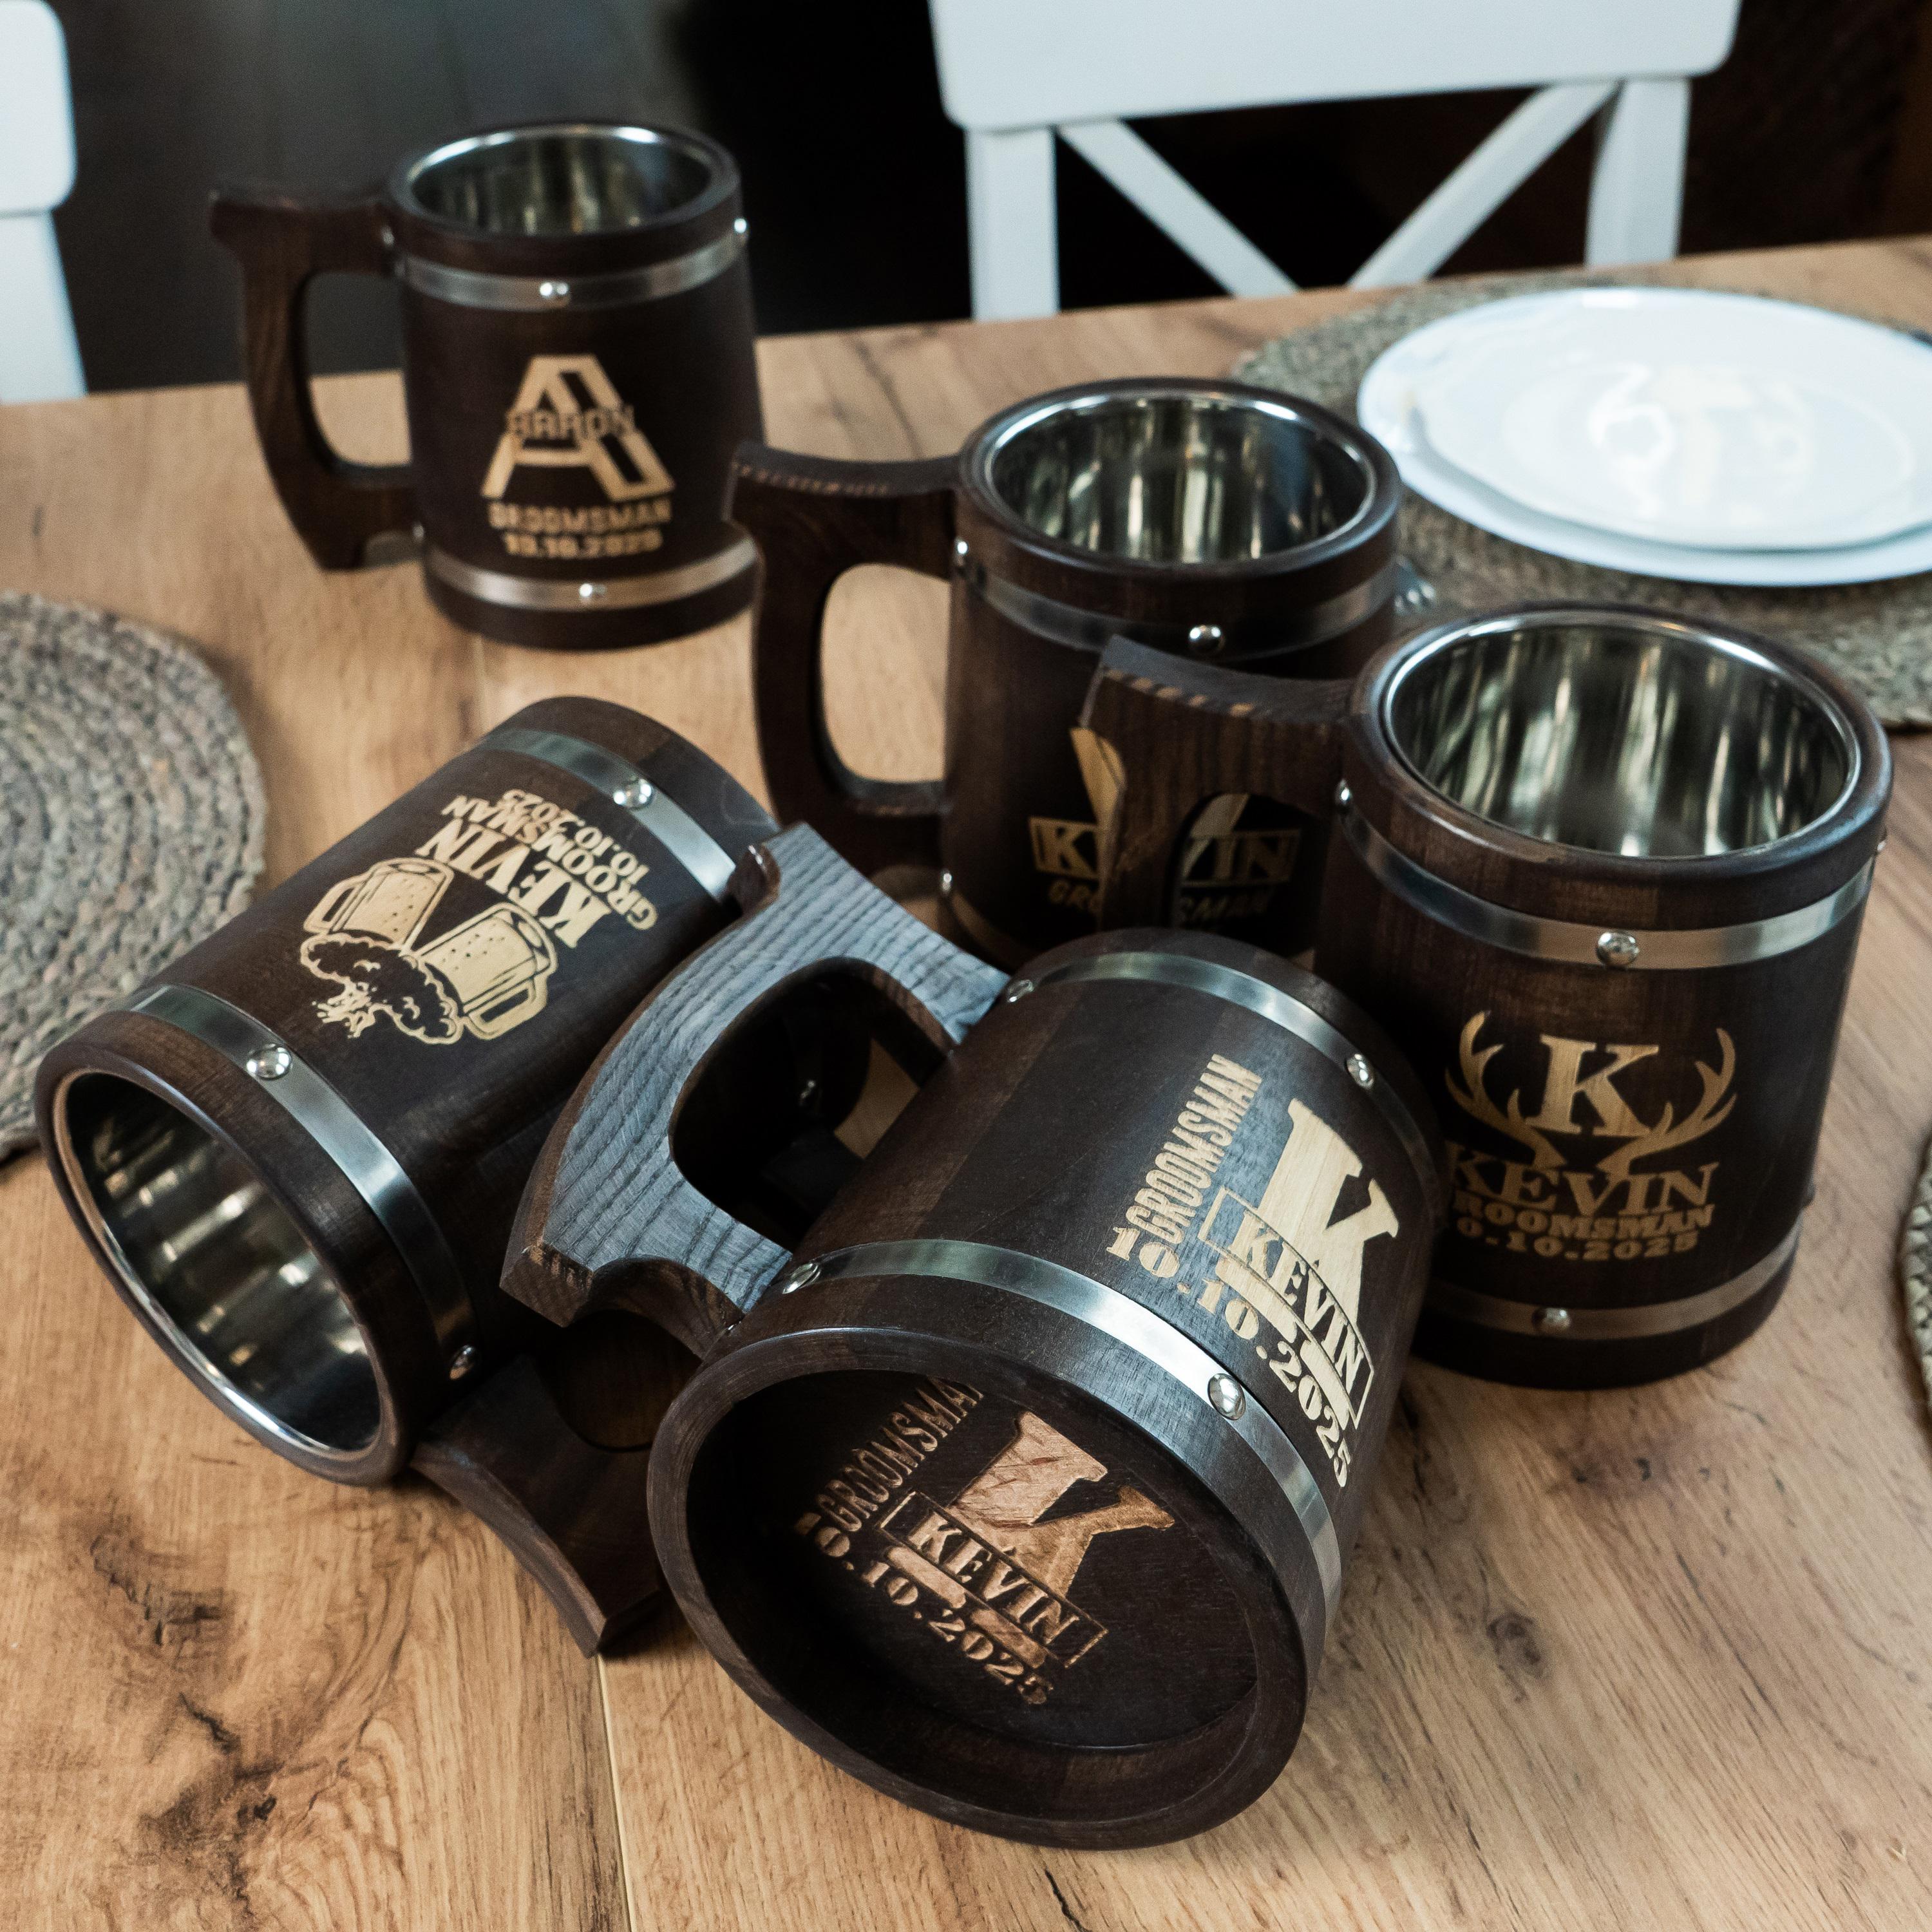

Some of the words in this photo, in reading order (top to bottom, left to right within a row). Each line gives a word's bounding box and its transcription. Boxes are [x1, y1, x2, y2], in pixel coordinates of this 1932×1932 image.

[482, 354, 674, 502] A
[415, 819, 612, 948] KEVIN
[441, 795, 658, 930] GROOMSMAN
[1126, 1054, 1262, 1244] GROOMSMAN
[1525, 1034, 1660, 1137] K
[1445, 1140, 1719, 1217] KEVIN
[1455, 1189, 1715, 1240] ROOMSMAN
[1216, 1098, 1399, 1431] K
[1226, 1209, 1364, 1395] KEVIN
[1106, 1227, 1351, 1487] 10.10.2025
[816, 1377, 983, 1532] GROOMSMA
[884, 1412, 1175, 1669] K
[905, 1511, 1079, 1645] KEVIN
